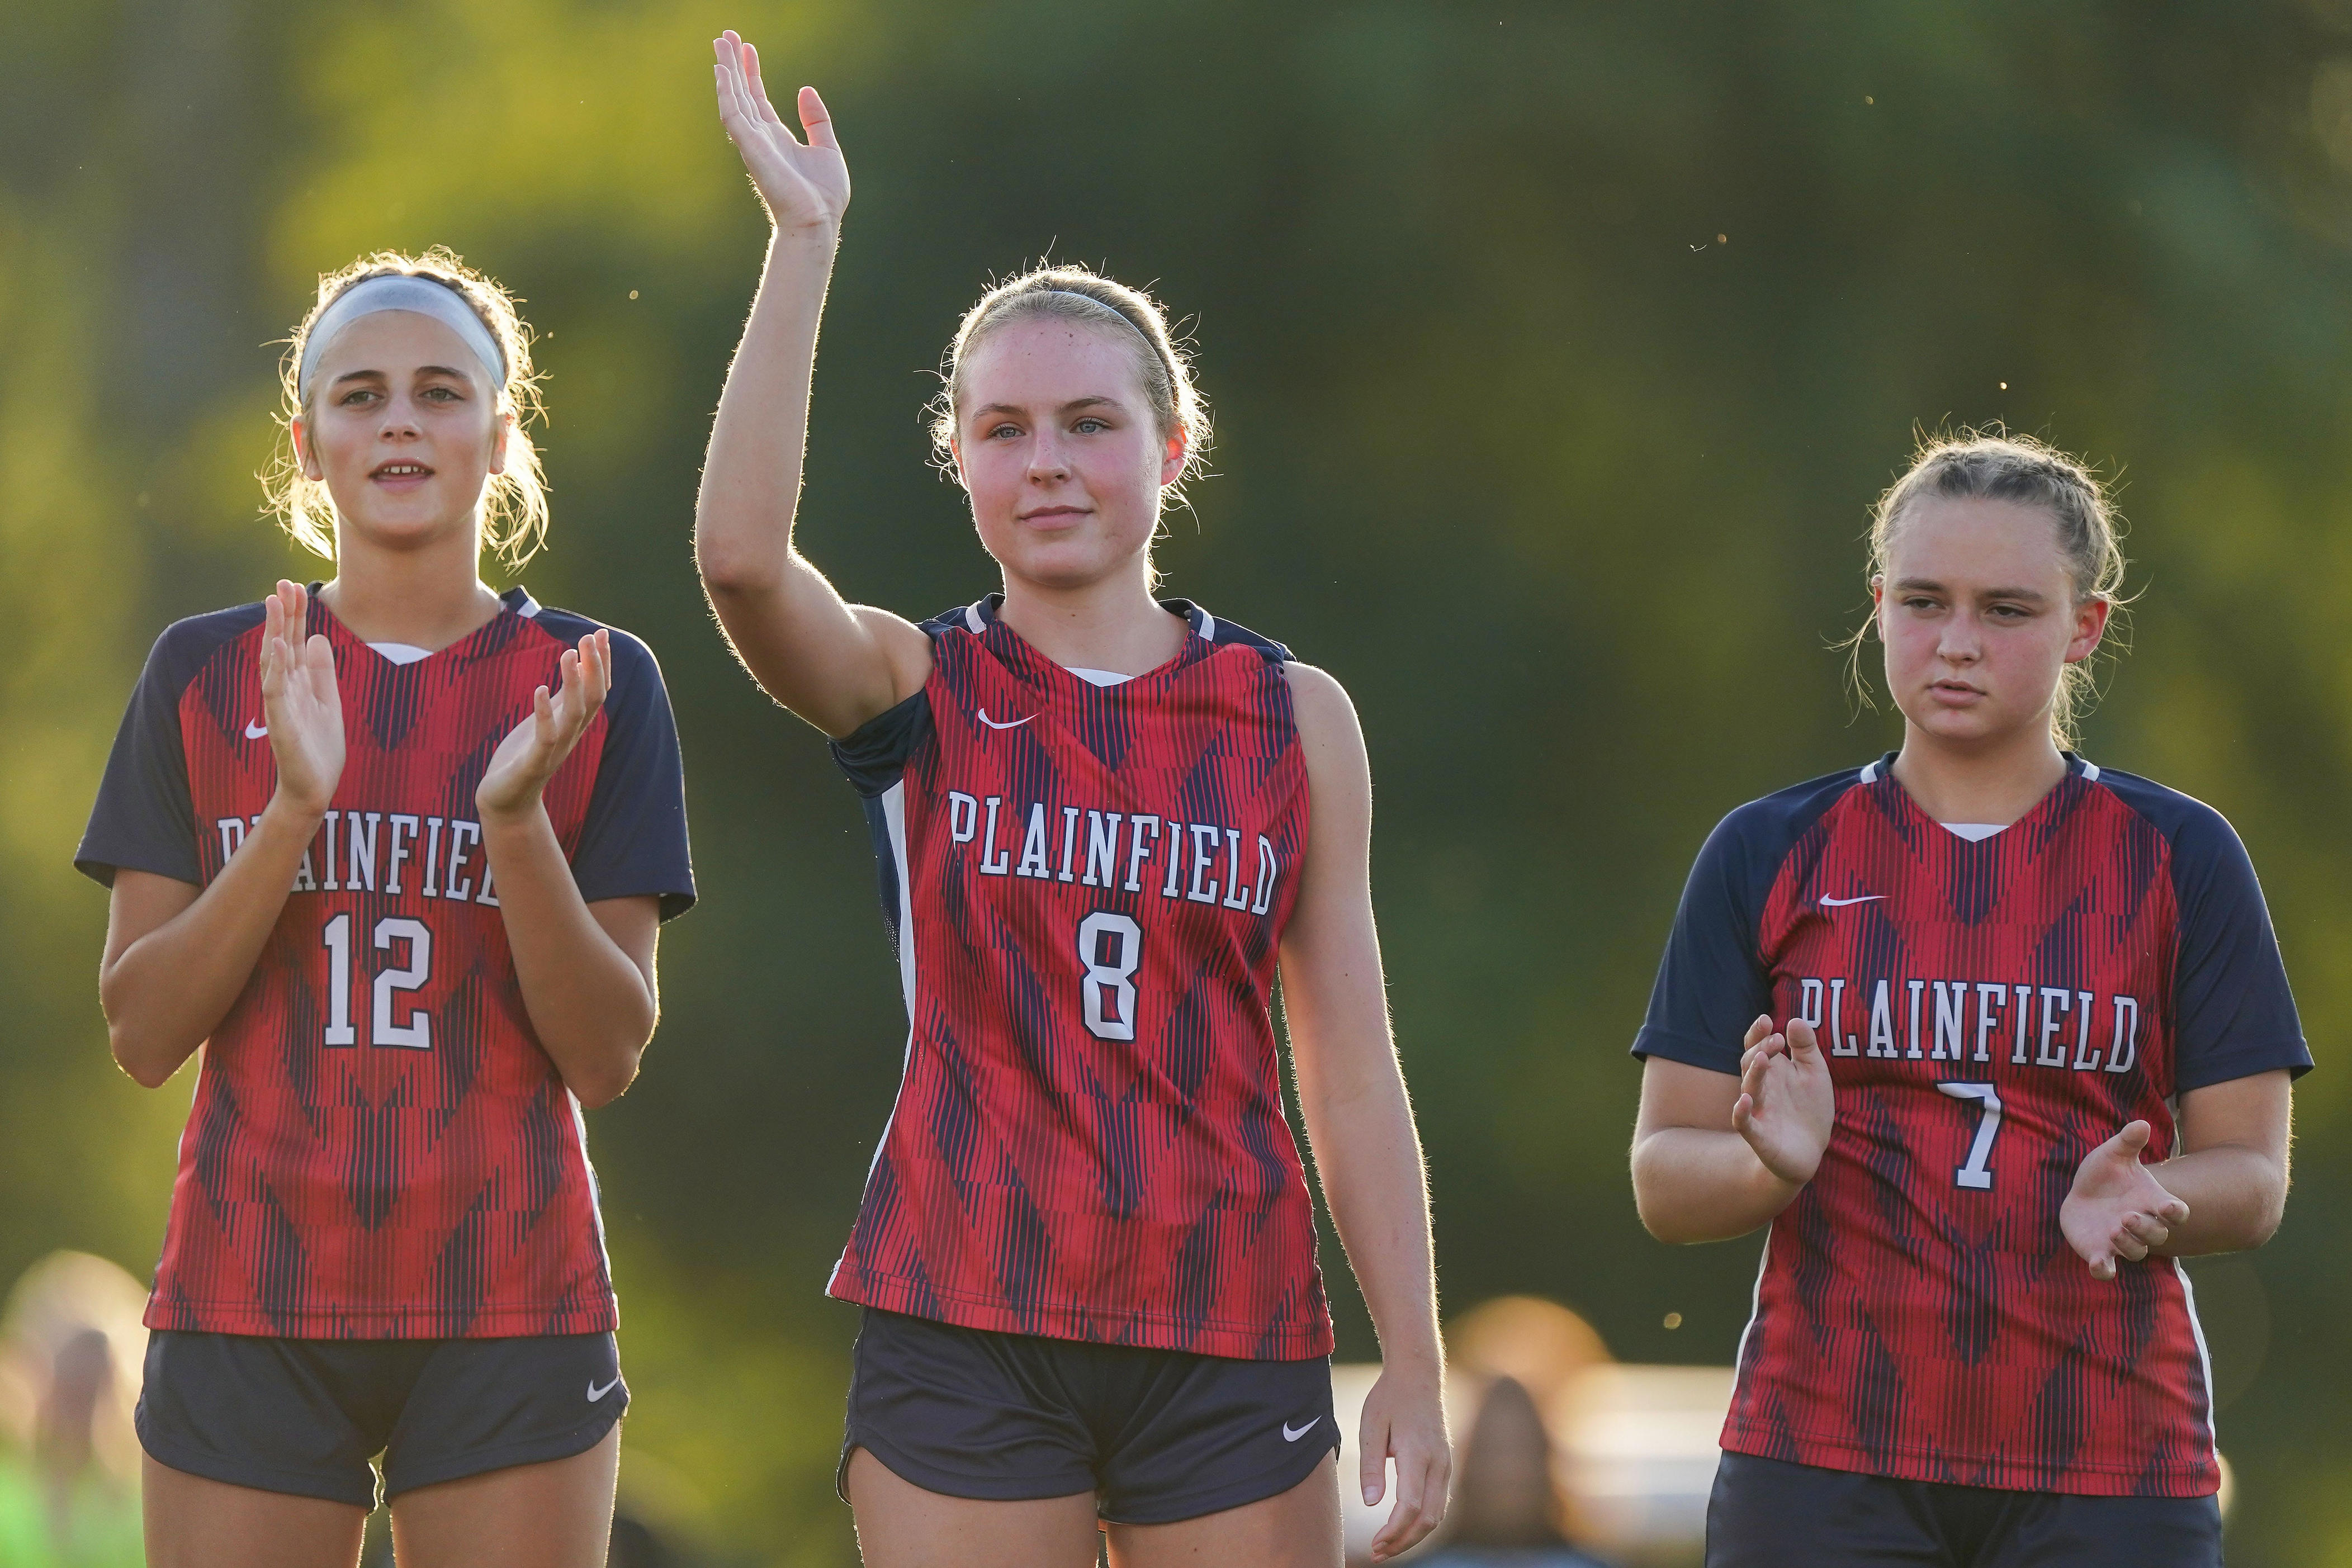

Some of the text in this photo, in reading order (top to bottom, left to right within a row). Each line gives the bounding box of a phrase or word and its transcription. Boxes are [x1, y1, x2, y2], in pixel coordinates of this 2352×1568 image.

[216, 809, 500, 908] PINFIE
[948, 790, 1277, 916] PLAINFIELD
[323, 913, 430, 1049] 12
[1078, 911, 1142, 1041] 8
[1800, 978, 2138, 1073] PLAINFIELD
[1935, 1082, 2002, 1189] 7
